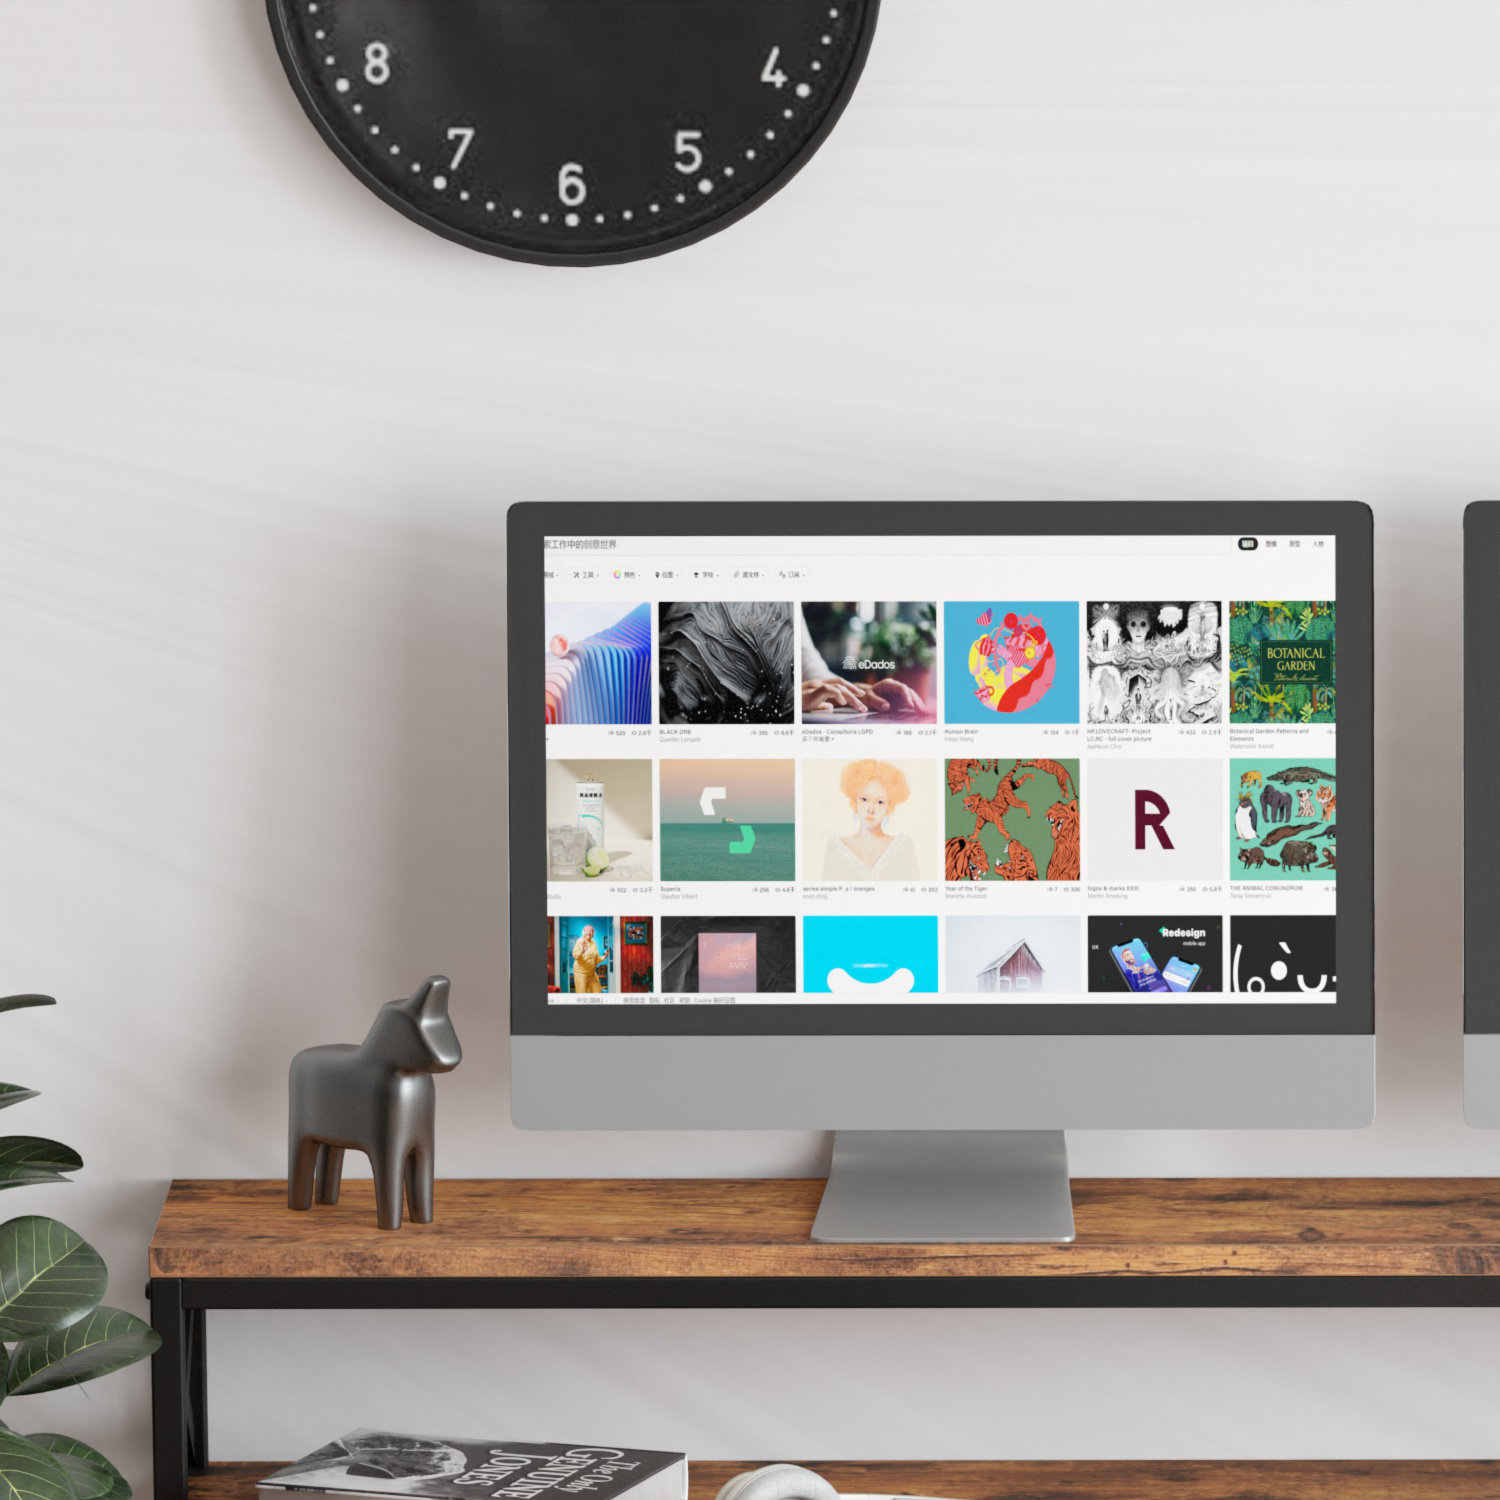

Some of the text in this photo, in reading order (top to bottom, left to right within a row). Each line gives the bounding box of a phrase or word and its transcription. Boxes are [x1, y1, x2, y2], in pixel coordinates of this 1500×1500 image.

[364, 42, 390, 84] 8
[760, 46, 788, 88] 4
[447, 128, 475, 170] 7
[674, 130, 702, 173] 5
[558, 163, 587, 206] 6
[858, 660, 896, 669] eDados
[1267, 648, 1326, 658] BOTANICAL
[1276, 661, 1316, 670] GARDEN
[1134, 789, 1175, 850] R
[1162, 928, 1206, 939] Redesign
[453, 1449, 557, 1487] JONES
[491, 1448, 625, 1500] GENUINE
[554, 1474, 613, 1493] Only
